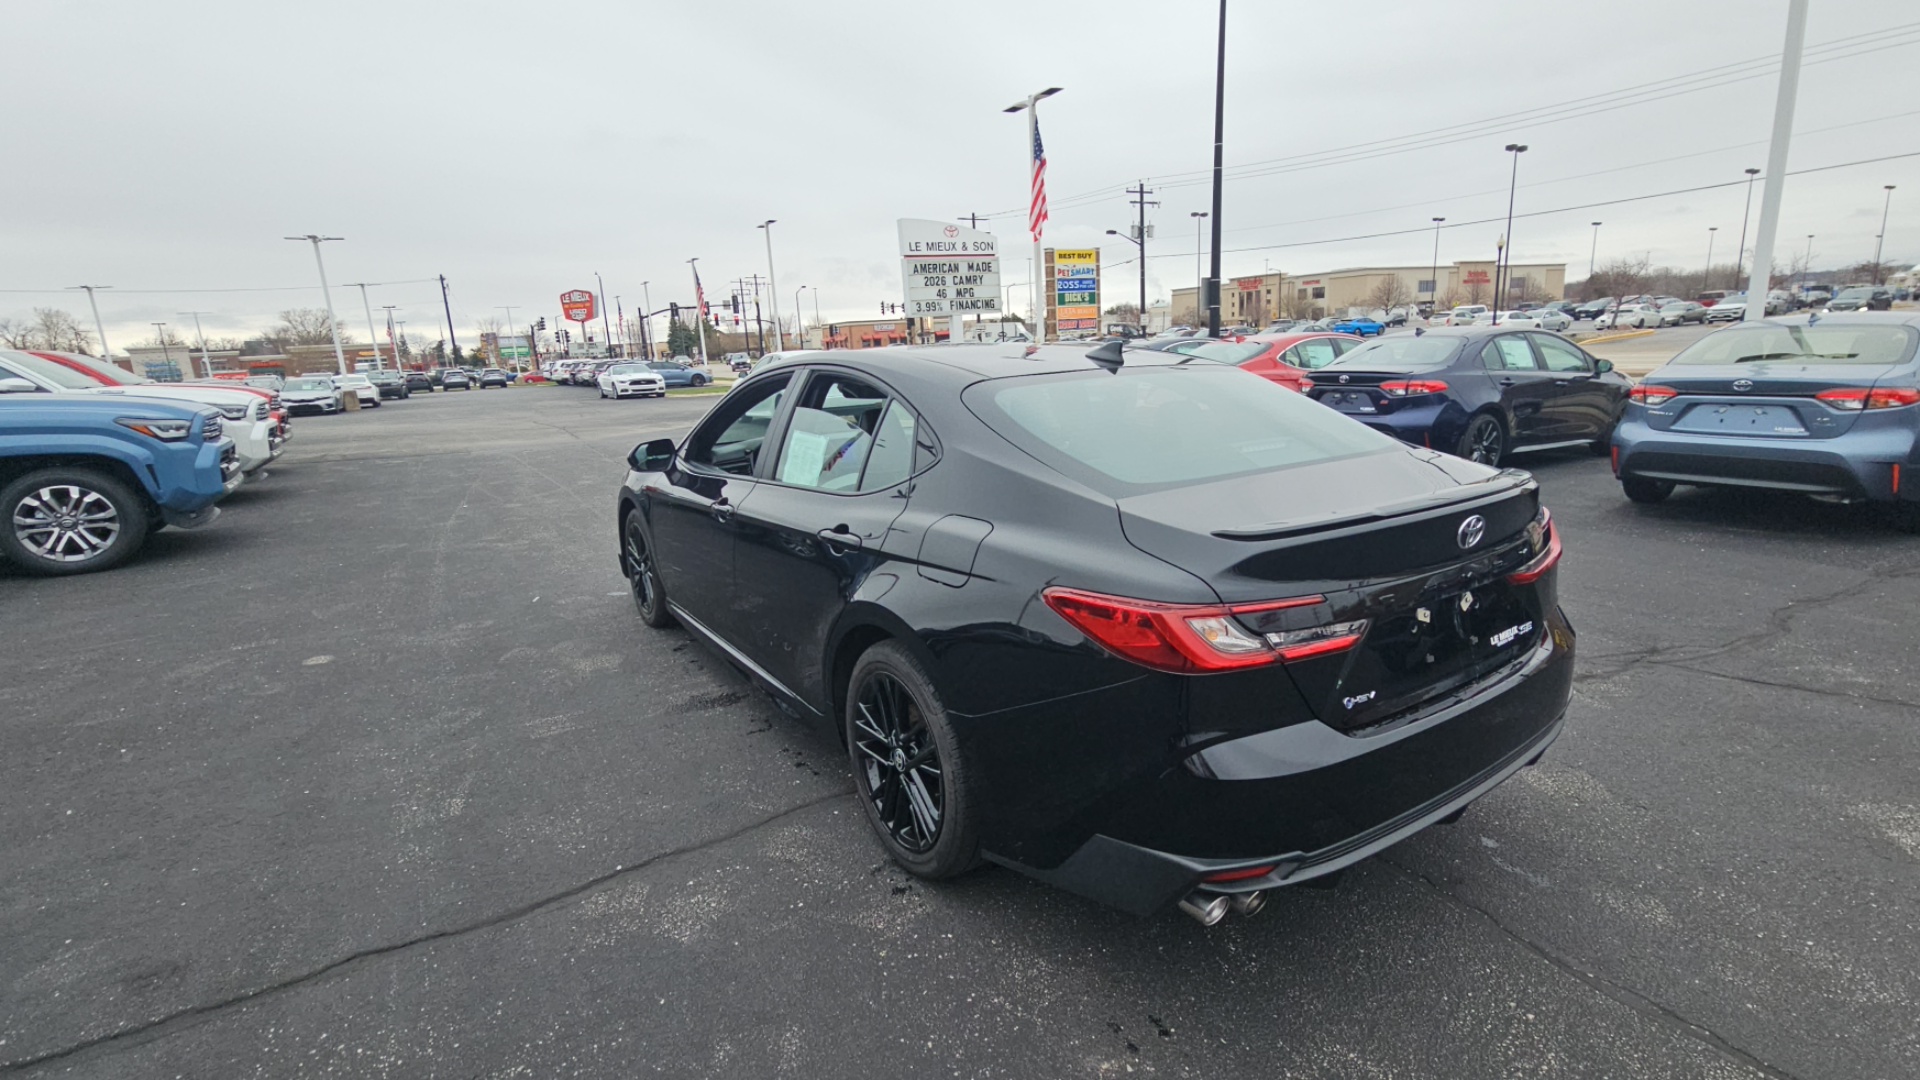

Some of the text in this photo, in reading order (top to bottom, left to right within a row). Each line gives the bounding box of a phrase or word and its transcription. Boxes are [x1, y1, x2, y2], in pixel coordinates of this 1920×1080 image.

[908, 241, 994, 252] LE MIEUX & SON
[1058, 252, 1093, 260] BEST BUY
[913, 261, 992, 274] AMERICAN MADE
[924, 274, 984, 287] 2026 CAMRY
[1058, 280, 1080, 289] ROSS
[562, 291, 591, 303] LE MIEUX
[936, 287, 975, 299] 46 MPG
[1064, 292, 1089, 302] DICK'S
[915, 298, 995, 312] 3.99% FINANCING
